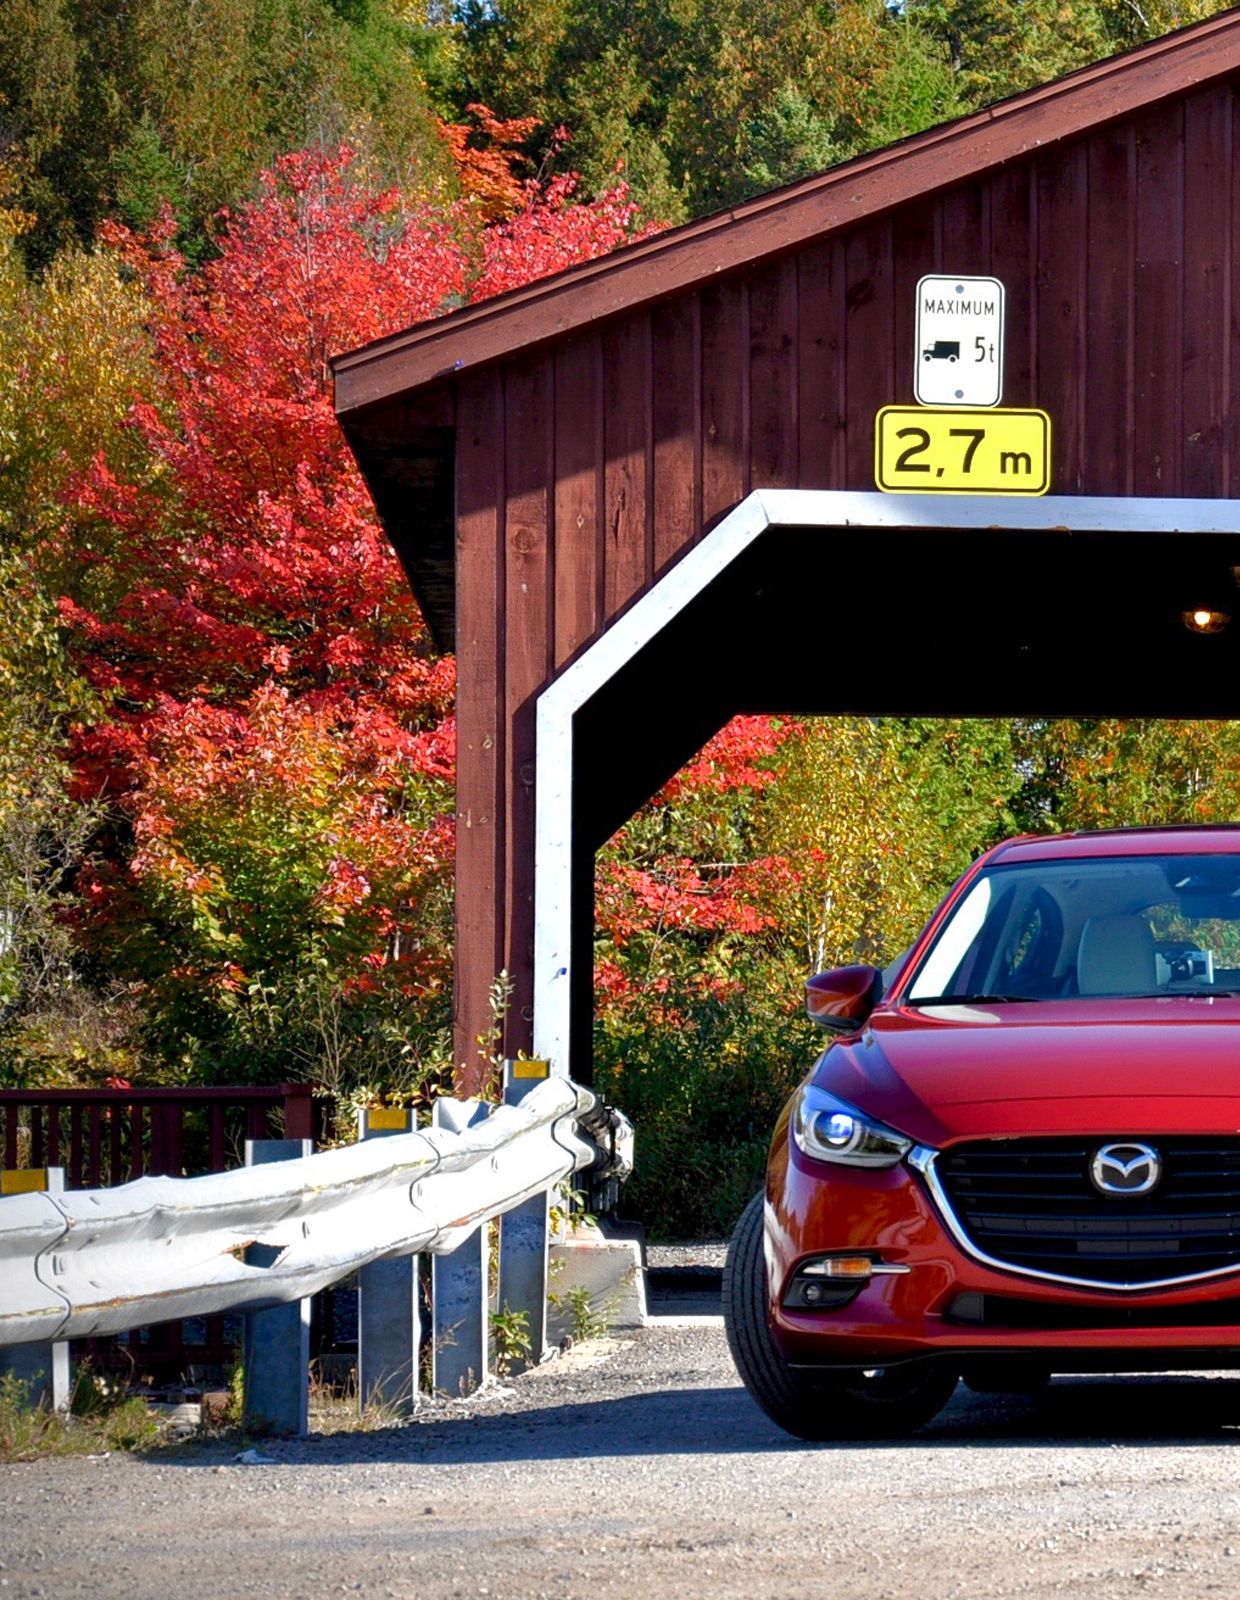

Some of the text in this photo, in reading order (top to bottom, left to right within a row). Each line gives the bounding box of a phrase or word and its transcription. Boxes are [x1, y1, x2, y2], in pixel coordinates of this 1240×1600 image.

[924, 298, 995, 316] MAXIMUM
[894, 427, 1032, 478] 2,7 m
